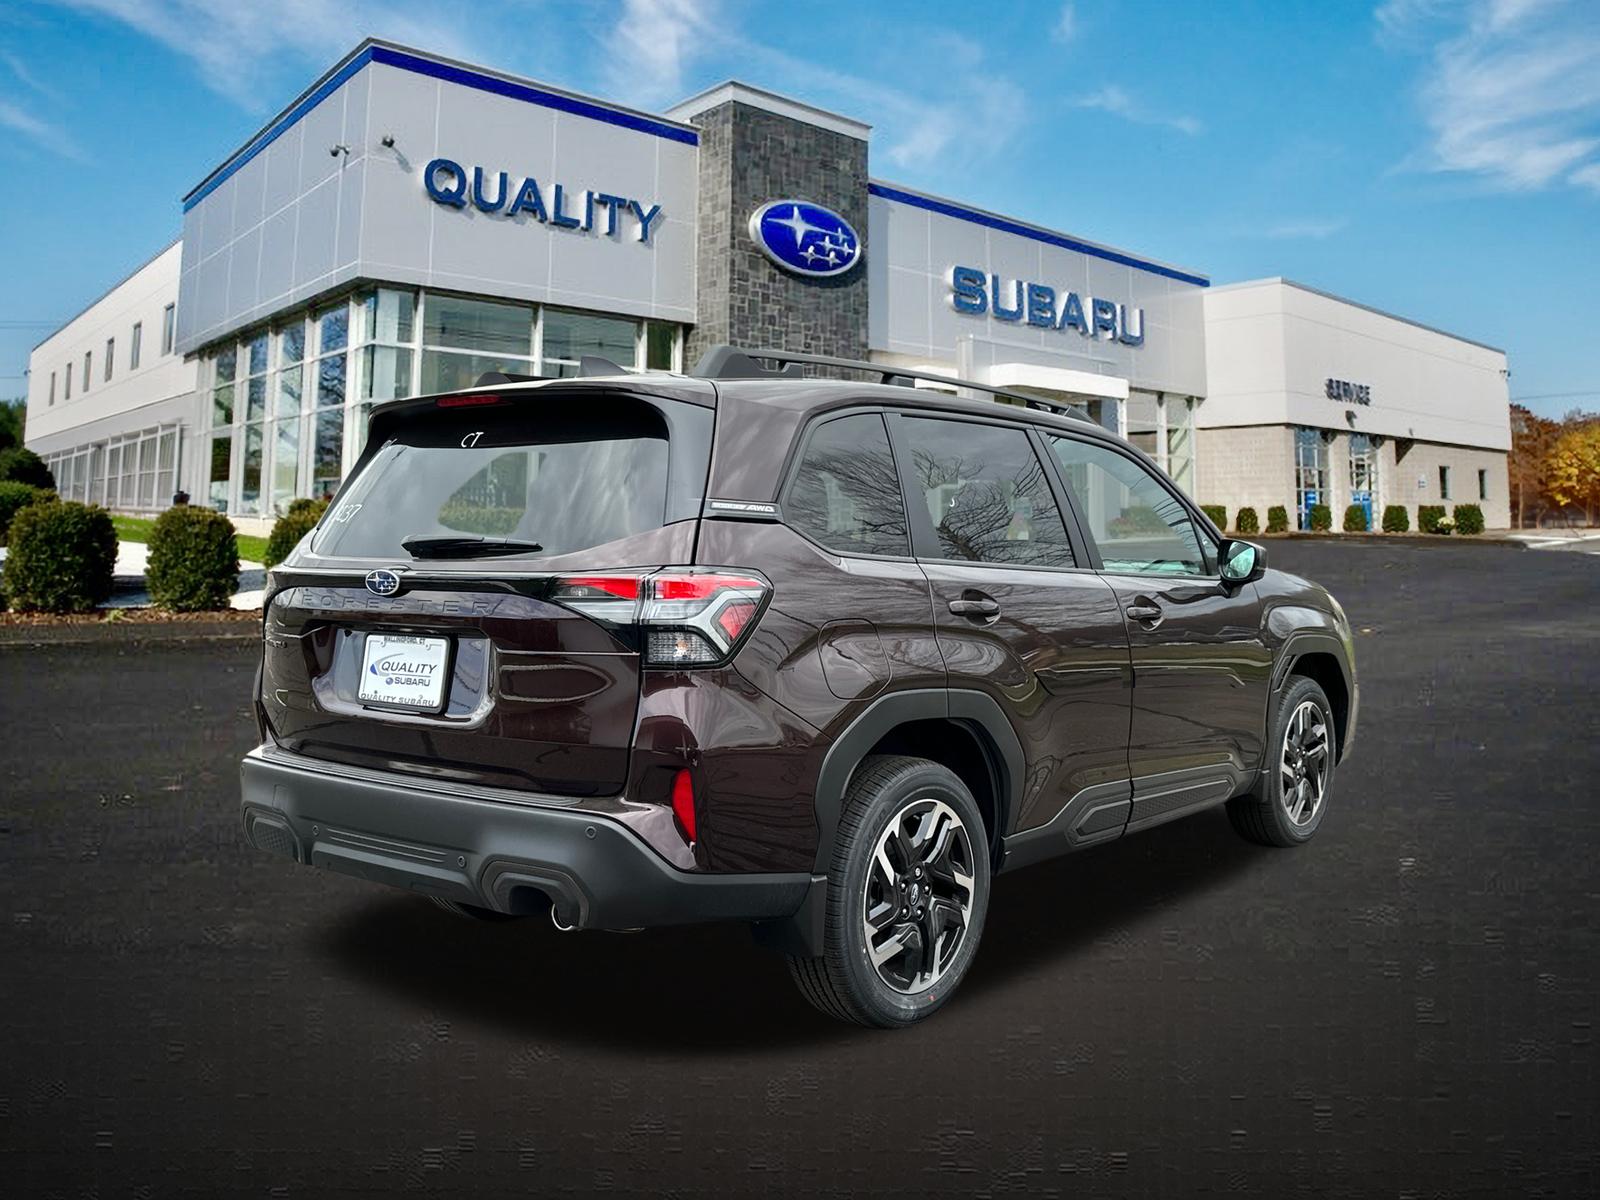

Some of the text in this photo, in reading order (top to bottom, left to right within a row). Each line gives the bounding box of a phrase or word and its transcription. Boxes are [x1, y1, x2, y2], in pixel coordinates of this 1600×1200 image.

[423, 158, 662, 243] QUALITY
[950, 265, 1145, 347] SUBARU
[1325, 378, 1371, 406] SERVICE
[746, 504, 775, 513] AWD
[301, 594, 491, 616] FORESTER
[381, 661, 437, 674] QUALITY
[394, 676, 431, 687] SUBARU
[360, 692, 435, 706] QUALITY SUBARU
